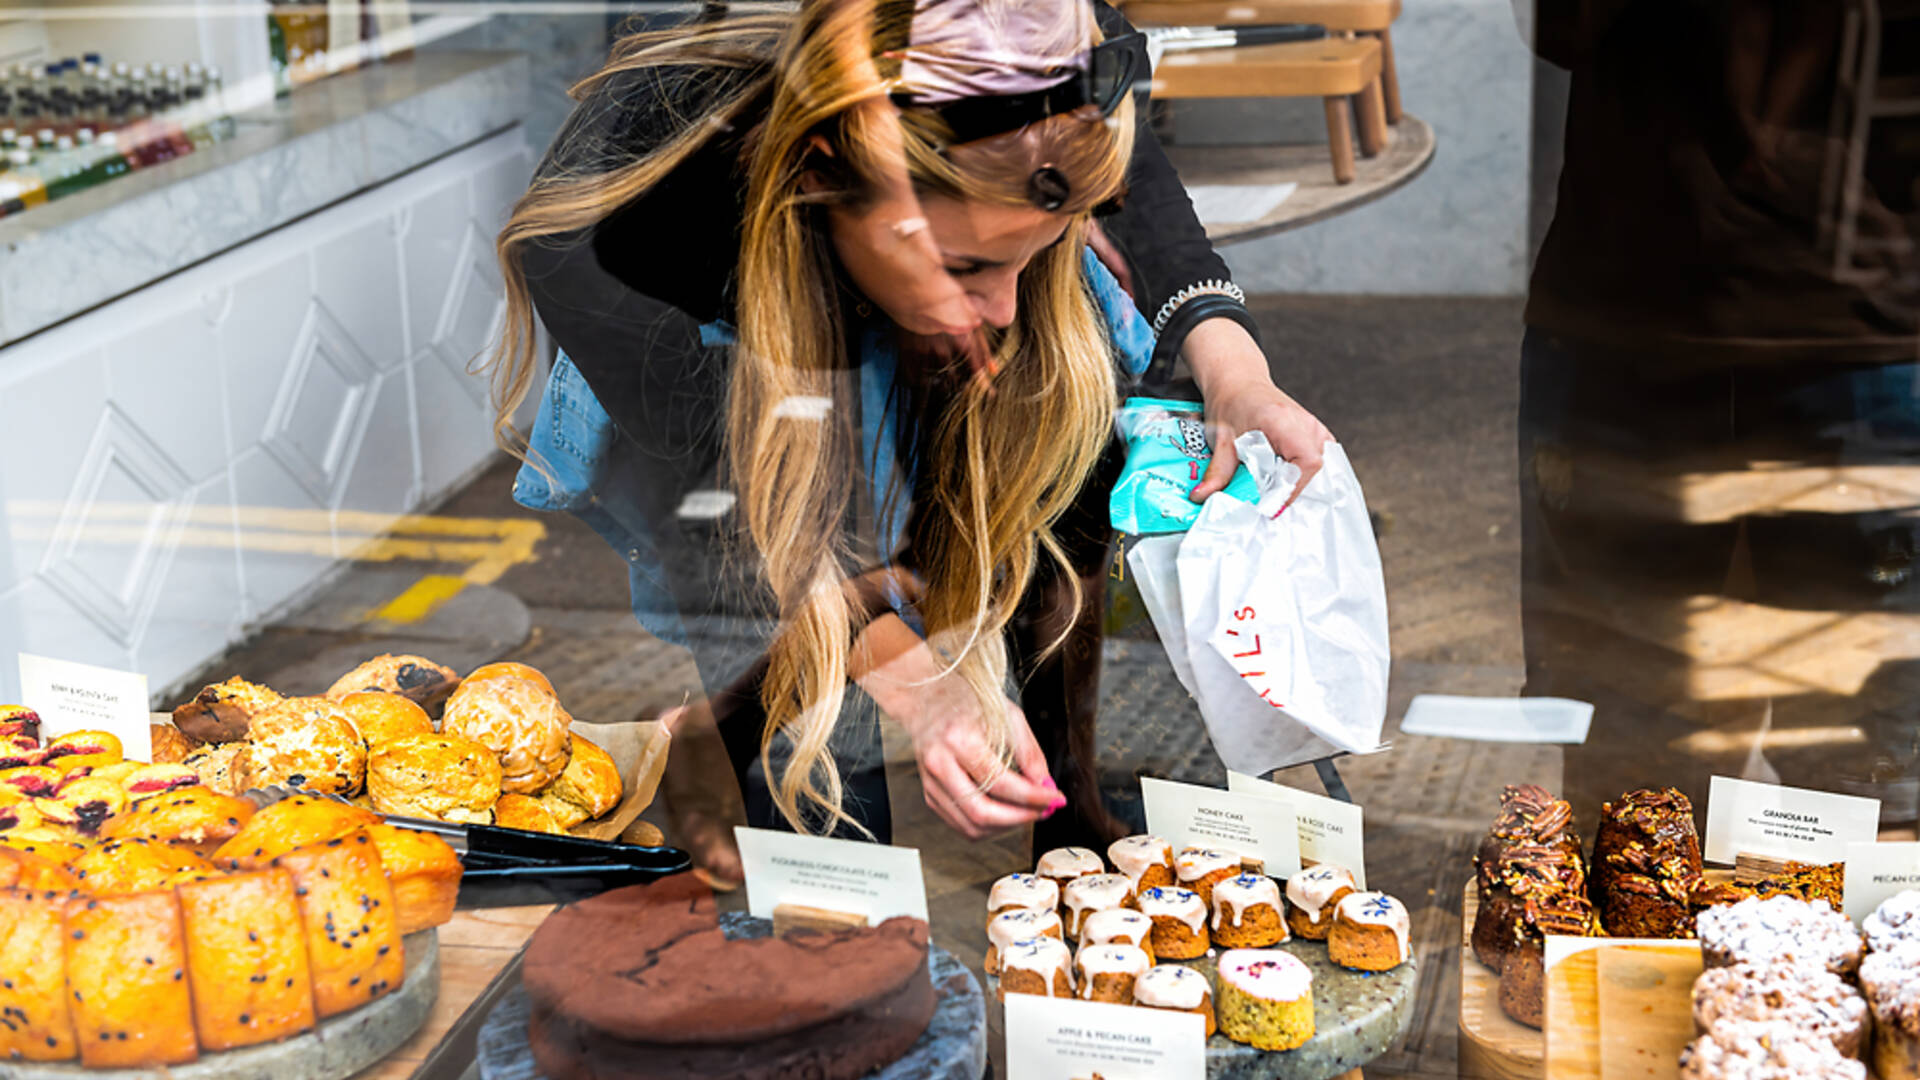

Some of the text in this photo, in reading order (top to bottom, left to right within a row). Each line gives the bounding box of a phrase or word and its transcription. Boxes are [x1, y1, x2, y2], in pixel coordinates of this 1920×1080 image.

[1197, 807, 1244, 821] HONEY CAKE
[1763, 809, 1819, 824] GRANOLA BAR
[1309, 818, 1325, 829] ROSE
[1326, 823, 1344, 834] CAKE
[816, 862, 865, 876] CHOCOLATE
[867, 868, 889, 880] CAKE
[1873, 874, 1906, 884] PECAN
[1058, 1027, 1151, 1045] APPLE & PECAN CAKE
